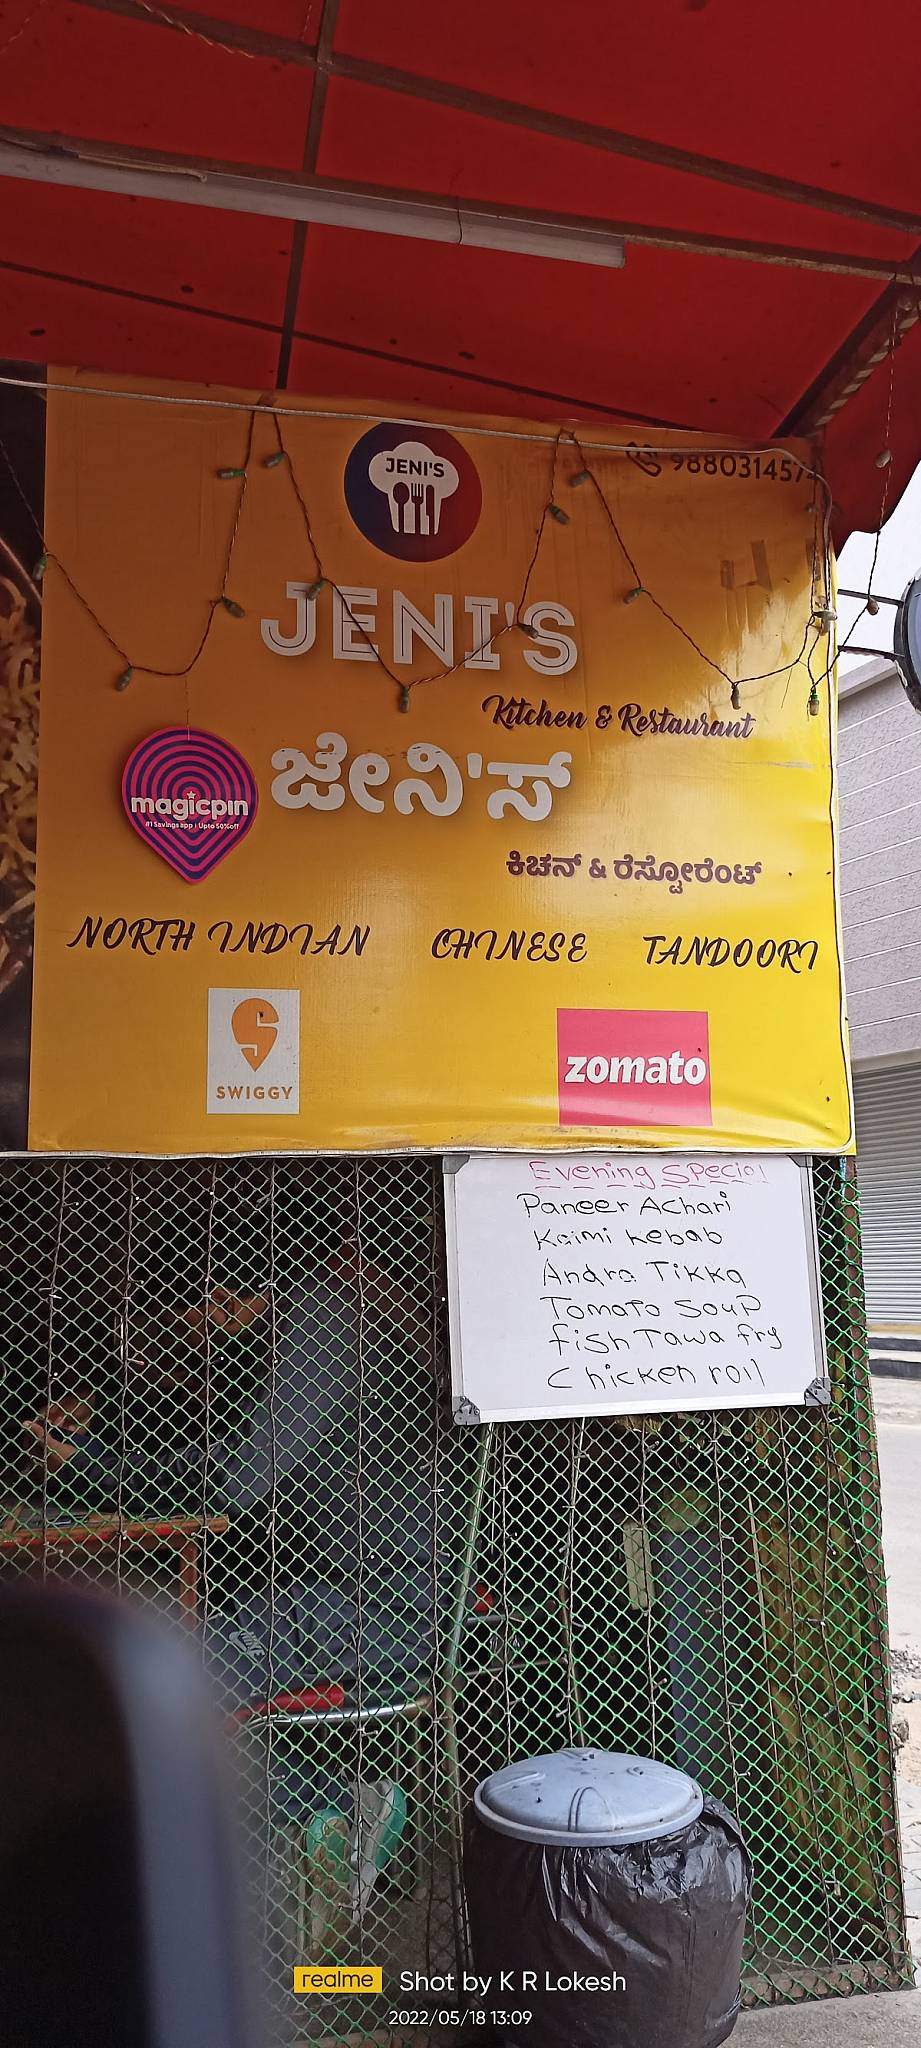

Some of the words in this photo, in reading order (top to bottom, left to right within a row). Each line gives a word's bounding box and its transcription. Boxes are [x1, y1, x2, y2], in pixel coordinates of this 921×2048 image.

[385, 457, 445, 478] JENI'S
[260, 581, 578, 676] JENI'S
[481, 694, 588, 730] Kitchen
[595, 704, 613, 730] &
[617, 703, 757, 739] Restaurant
[130, 792, 249, 820] magicpin
[179, 822, 193, 830] app
[198, 822, 214, 830] Upto
[506, 850, 582, 878] ಕಿಚನ್
[588, 858, 607, 879] &
[66, 915, 196, 956] NORTH
[207, 920, 371, 957] INDIAN
[431, 928, 588, 963] CHINESE
[642, 935, 819, 974] TANDOORI
[564, 1050, 706, 1086] zomato
[216, 1084, 293, 1100] SWIGGY
[529, 1161, 656, 1190] Evening
[517, 1193, 630, 1218] Paneer
[543, 1258, 637, 1287] Andra
[645, 1261, 747, 1289] Tikka
[633, 1329, 725, 1348] Tawa
[547, 1363, 697, 1389] Chicken
